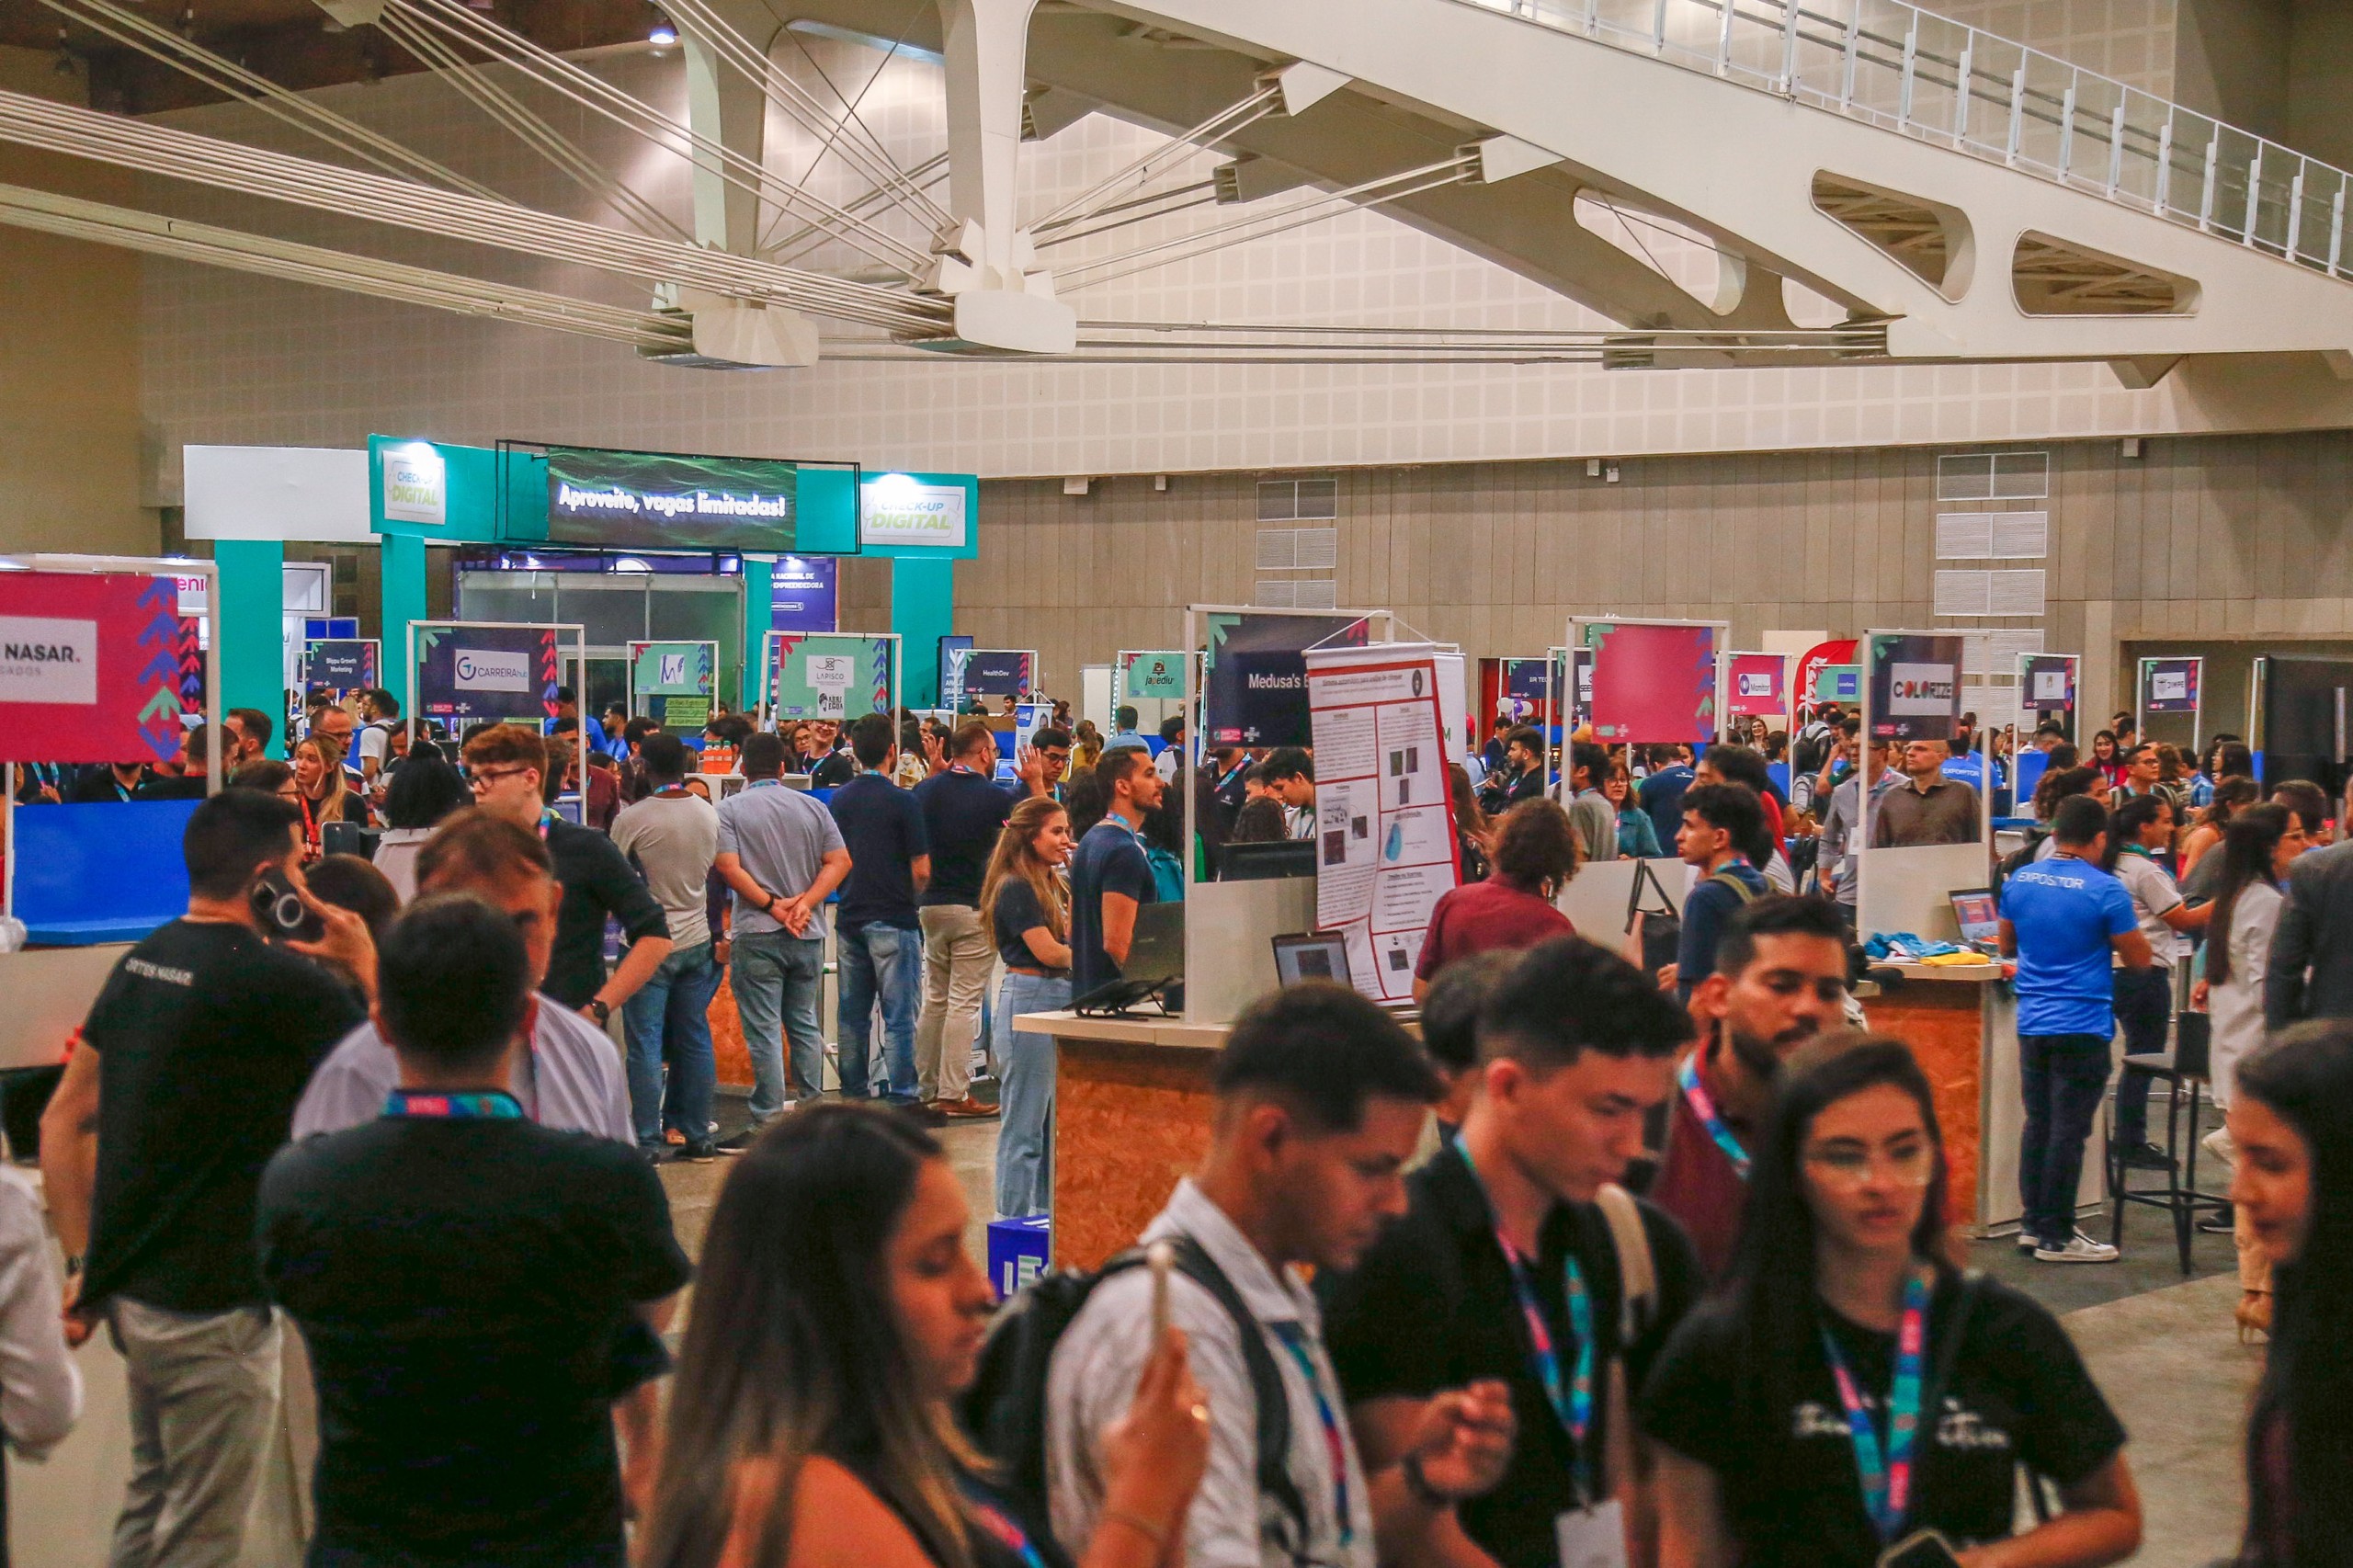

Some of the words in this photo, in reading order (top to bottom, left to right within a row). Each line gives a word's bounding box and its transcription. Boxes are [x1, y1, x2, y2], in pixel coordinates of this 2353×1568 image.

[392, 484, 438, 506] DIGITAL
[558, 484, 641, 514] Aproveite,
[643, 494, 695, 517] vagas
[697, 489, 787, 517] limitadas!
[870, 512, 952, 530] DIGITAL
[1248, 673, 1302, 688] Medusa's
[2017, 870, 2086, 890] EXPOSITOR
